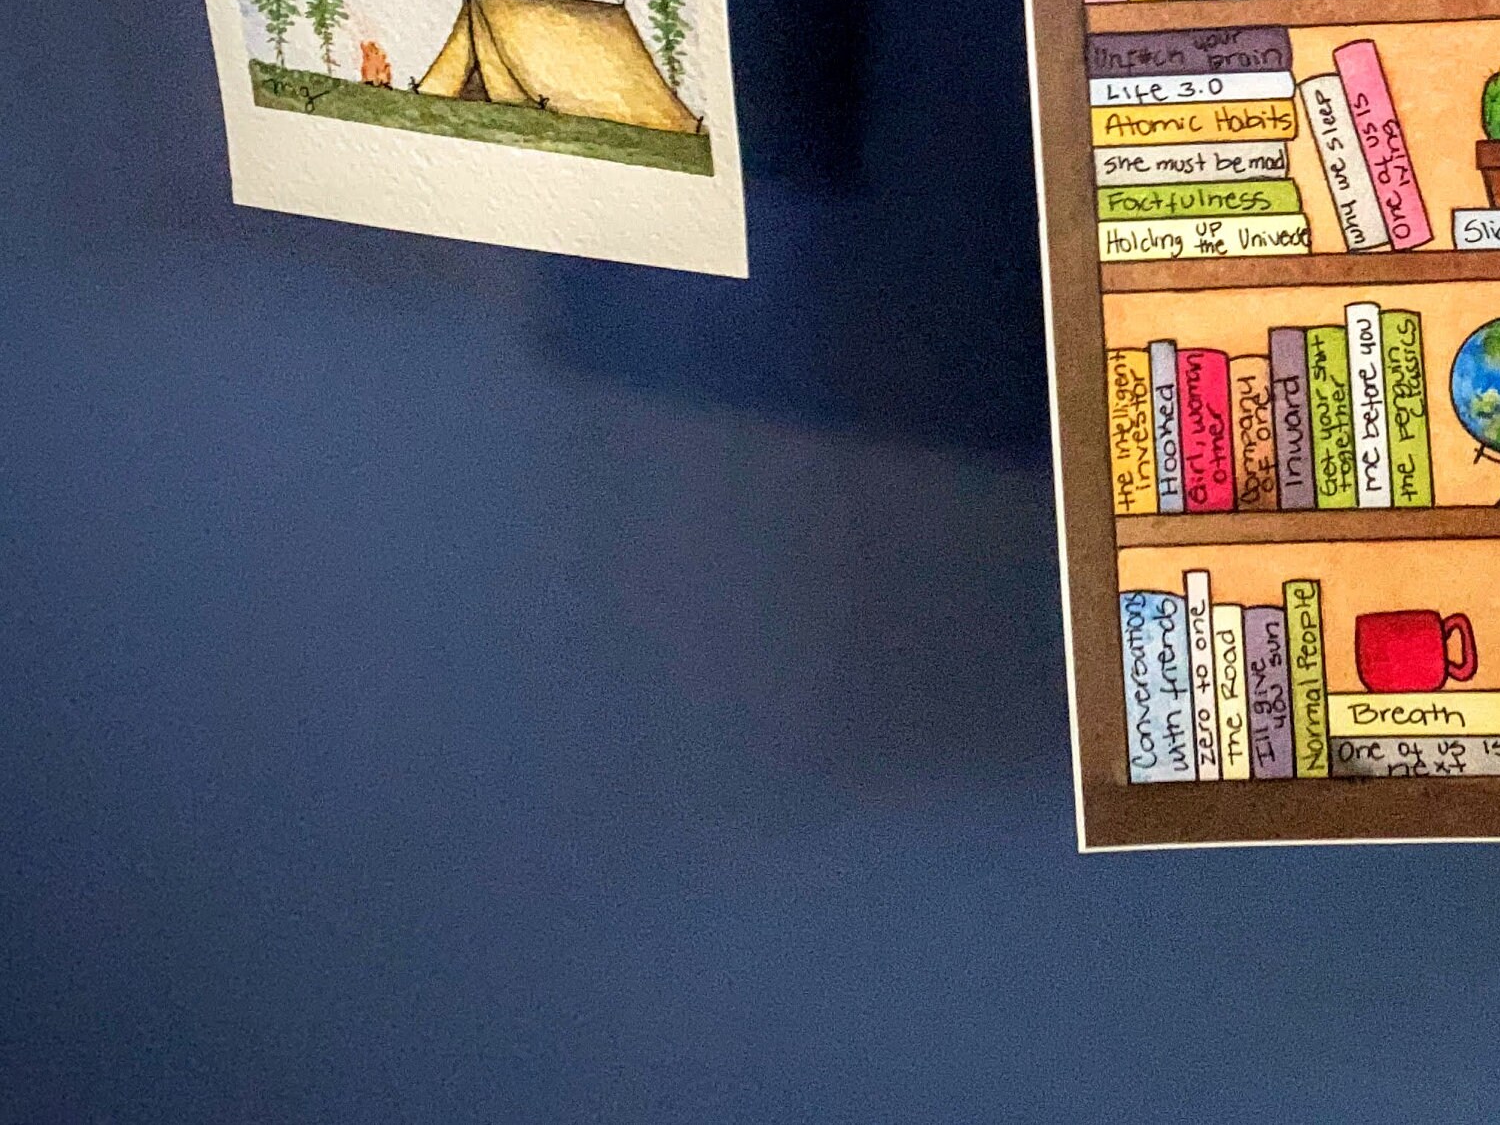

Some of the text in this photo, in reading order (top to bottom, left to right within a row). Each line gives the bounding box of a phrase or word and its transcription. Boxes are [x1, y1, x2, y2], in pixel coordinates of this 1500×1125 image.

[1107, 78, 1223, 103] Life 3.0
[1105, 105, 1291, 137] Atomic Habits
[1156, 154, 1205, 173] must
[1215, 153, 1245, 172] be
[1249, 149, 1286, 170] mad
[1331, 157, 1350, 190] we
[1375, 155, 1393, 184] of
[1107, 189, 1271, 212] Factfulness
[1107, 229, 1184, 258] Holding
[1194, 238, 1228, 255] the
[1130, 369, 1151, 490] investor
[1316, 389, 1333, 440] your
[1357, 319, 1383, 491] me before you
[1156, 384, 1178, 496] Hooked
[1207, 403, 1226, 484] other
[1237, 376, 1260, 503] Company
[1255, 387, 1275, 492] of one
[1274, 376, 1303, 486] Inward
[1330, 375, 1352, 492] together
[1117, 471, 1135, 511] the
[1320, 449, 1337, 496] Get
[1397, 455, 1418, 501] the
[1191, 599, 1207, 649] one
[1124, 592, 1157, 768] Conversations
[1153, 598, 1189, 771] with friends
[1197, 667, 1210, 693] to
[1216, 630, 1239, 701] Road
[1252, 657, 1273, 714] give
[1266, 622, 1287, 728] you sun
[1294, 588, 1325, 770] Normal People
[1348, 703, 1465, 727] Breath
[1339, 741, 1385, 760] One
[1398, 742, 1423, 762] of
[1438, 741, 1466, 756] us
[1388, 758, 1466, 776] next
